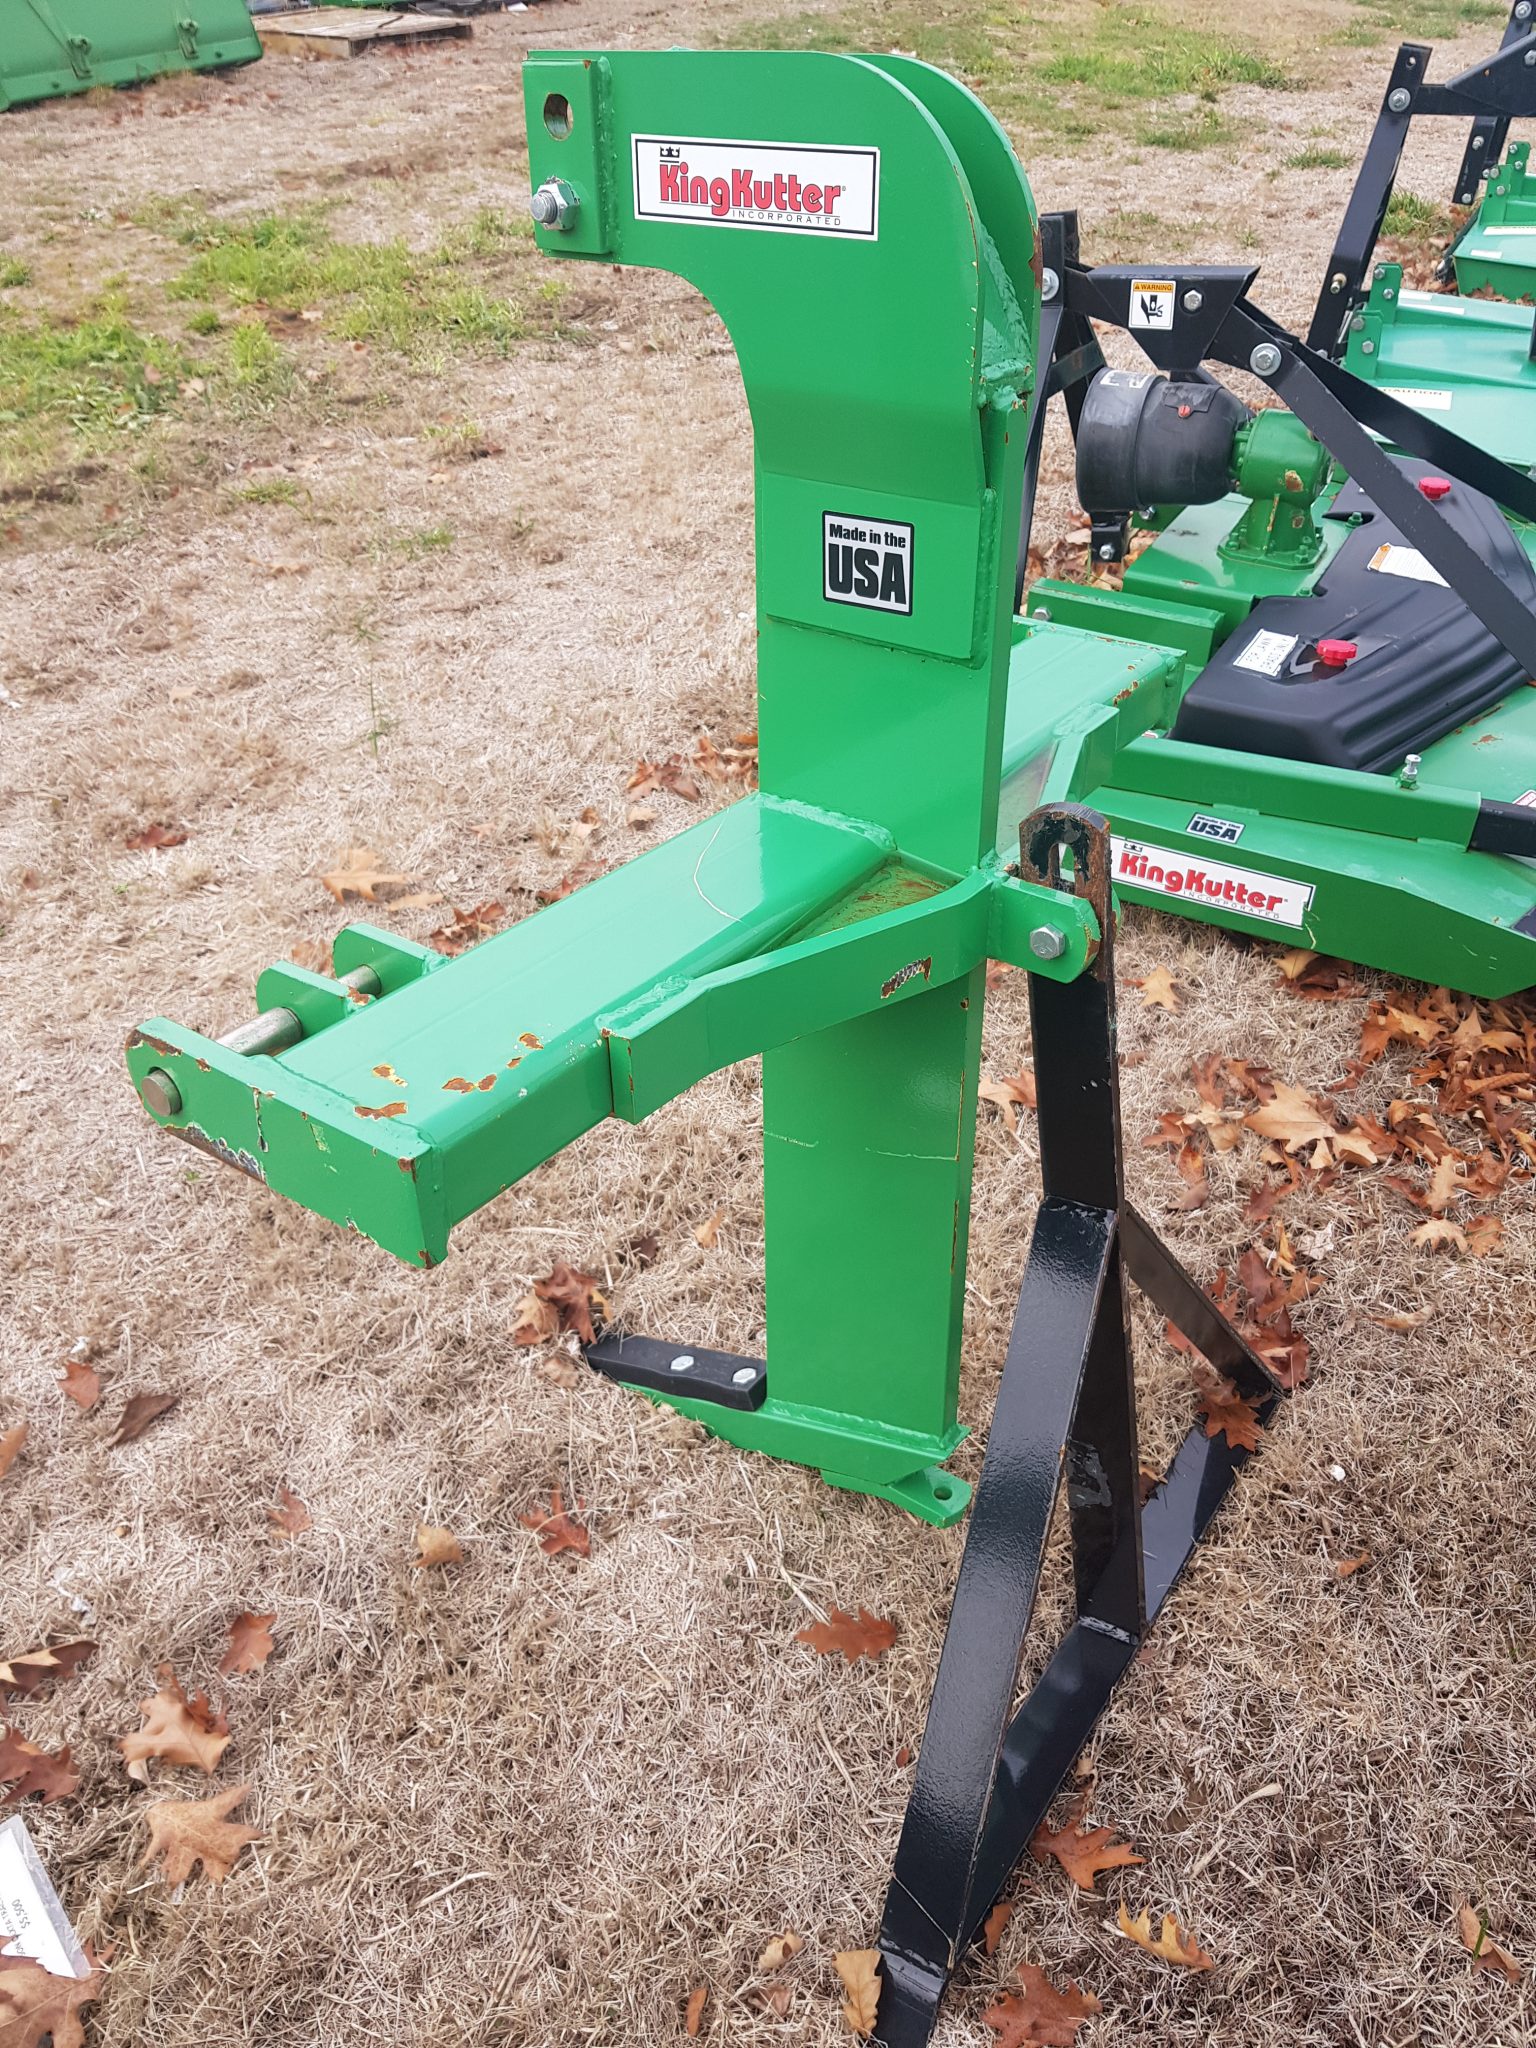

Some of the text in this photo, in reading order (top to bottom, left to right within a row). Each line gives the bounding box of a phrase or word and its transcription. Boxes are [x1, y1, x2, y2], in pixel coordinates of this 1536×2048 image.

[660, 161, 841, 216] KingKutter
[732, 208, 841, 226] INCORPORATED
[829, 523, 906, 548] Made in the
[828, 542, 907, 605] USA
[1190, 820, 1237, 841] USA
[1119, 853, 1284, 912] KingKutter
[1181, 889, 1281, 920] INCORPORATED
[11, 1898, 31, 1929] $5,500
